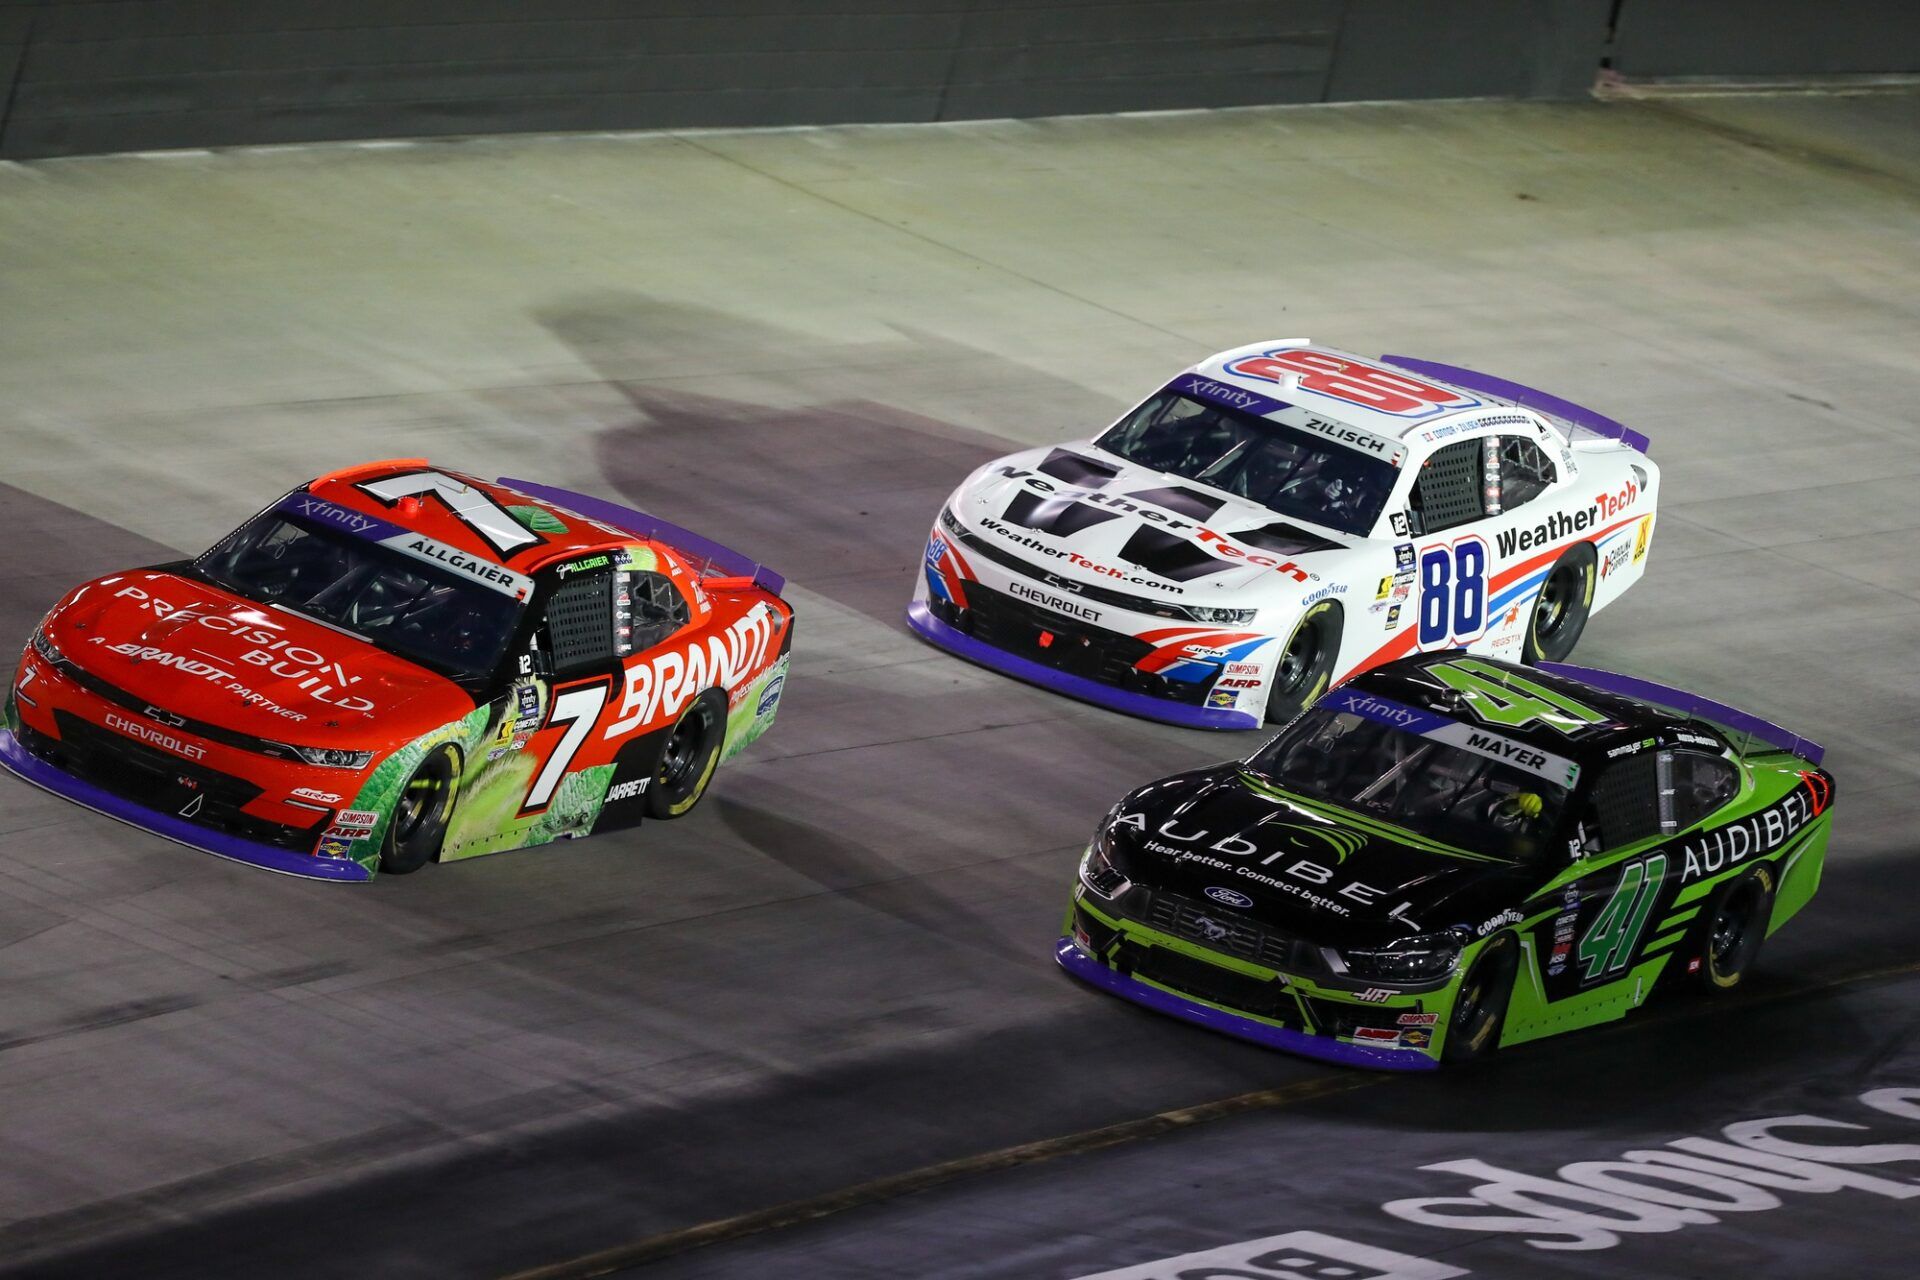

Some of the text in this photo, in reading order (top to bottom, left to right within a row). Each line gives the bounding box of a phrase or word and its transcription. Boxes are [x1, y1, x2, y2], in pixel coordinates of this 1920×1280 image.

[1186, 379, 1261, 409] xfinity
[1226, 349, 1480, 417] 88
[1306, 418, 1386, 452] ZILISCH
[297, 499, 379, 533] xfinity
[352, 470, 542, 556] 7
[1393, 515, 1406, 534] 12
[1496, 480, 1636, 559] WeatherTech
[408, 541, 514, 587] ALLGAIER
[980, 518, 1183, 594] WeatherTech.com
[1009, 582, 1102, 622] CHEVROLET
[1302, 582, 1348, 606] GOODYEAR
[1419, 540, 1485, 644] 88
[114, 586, 363, 687] PRECISION
[1186, 647, 1225, 656] JRM
[88, 637, 308, 722] A BRANDT PARTNER
[240, 650, 374, 712] BUILD
[519, 654, 531, 674] 12
[604, 600, 771, 741] BRANDT
[1217, 678, 1262, 688] ARP
[1227, 663, 1260, 675] SIMPSON
[1342, 695, 1423, 726] xfinity
[1422, 658, 1611, 736] 41
[105, 713, 207, 760] CHEVROLET
[521, 682, 610, 811] 7
[1467, 733, 1546, 770] MAYER
[295, 789, 336, 801] JRM
[605, 777, 651, 803] JARRETT
[326, 828, 371, 837] ARP
[341, 812, 375, 824] SIMPSON
[1569, 839, 1580, 858] 12
[1681, 792, 1812, 883] AUDIBEL
[1108, 813, 1420, 932] AUDIBEL
[1144, 840, 1350, 917] Hear better. Connect better.
[1211, 888, 1245, 907] Ford
[1477, 908, 1524, 936] GOODYEAR
[1579, 854, 1667, 980] 41
